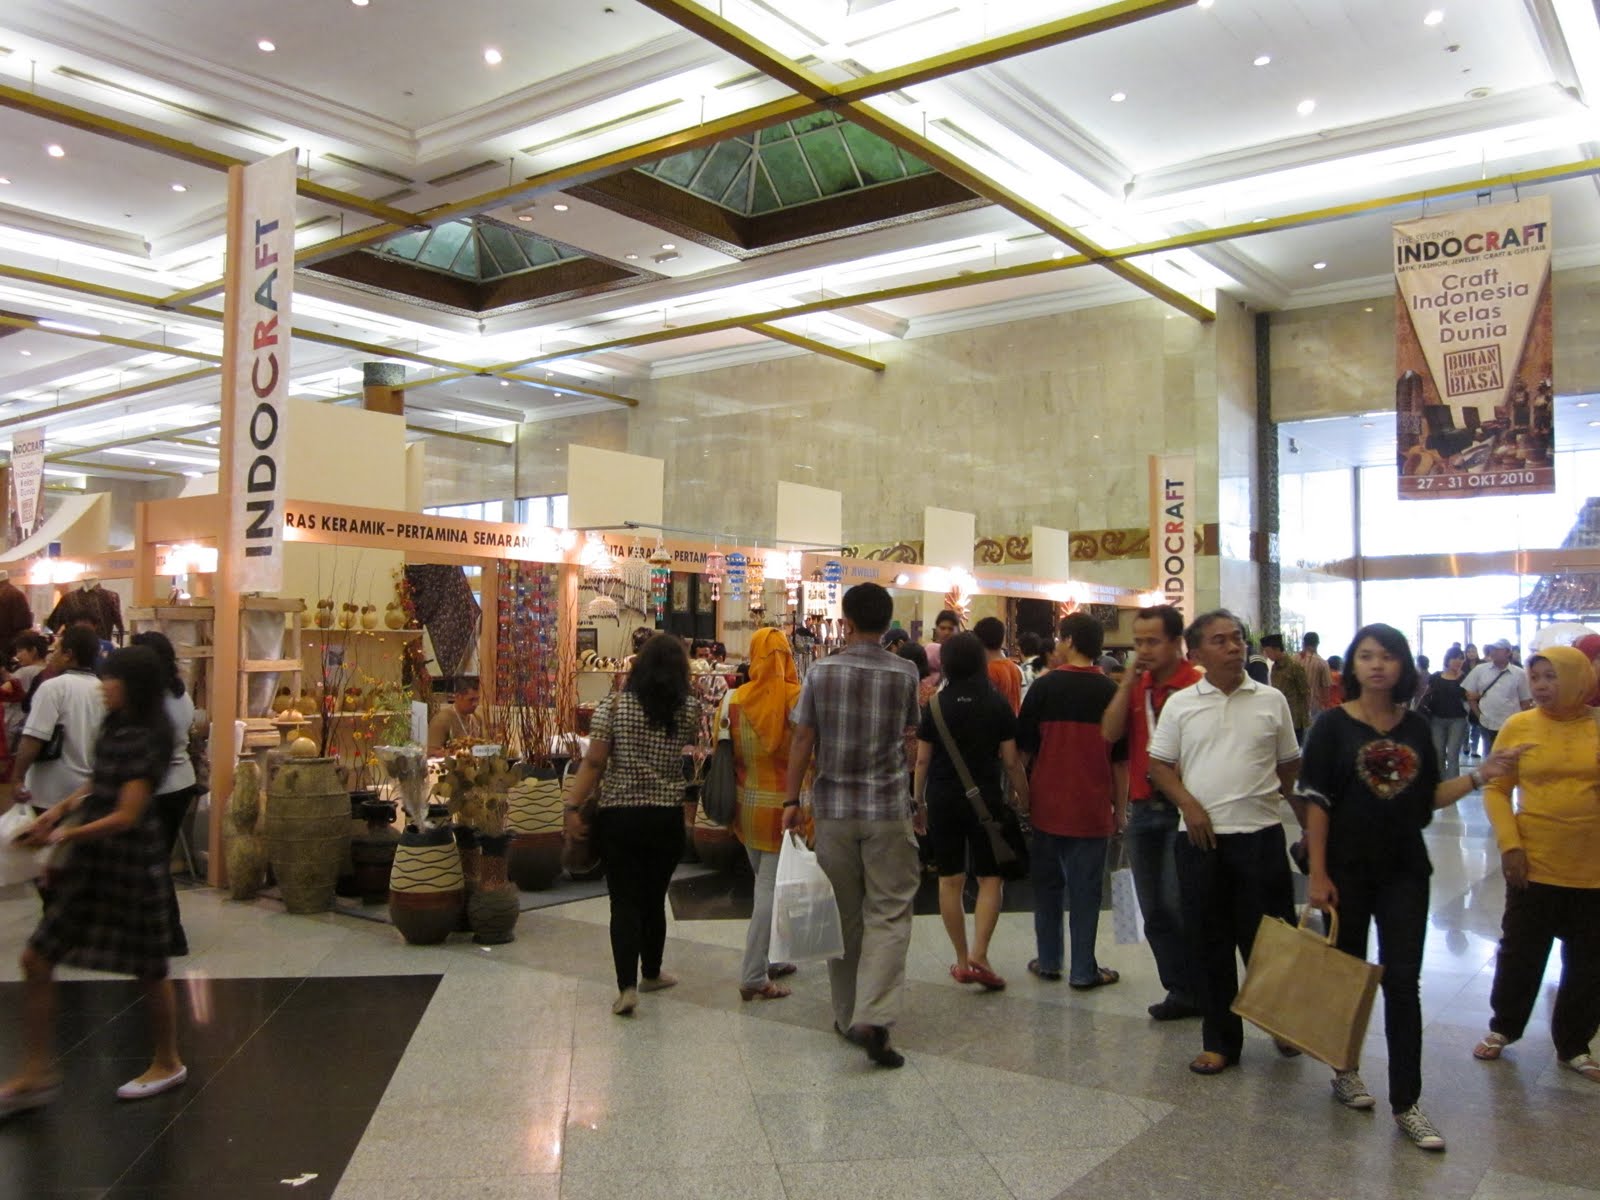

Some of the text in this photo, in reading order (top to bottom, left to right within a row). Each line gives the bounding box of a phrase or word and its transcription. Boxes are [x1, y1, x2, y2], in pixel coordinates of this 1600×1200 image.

[1397, 222, 1547, 265] INDOCRAFT
[1416, 229, 1455, 242] SEVENTH
[1441, 268, 1499, 291] Craft
[1413, 283, 1529, 310] Indonesia
[1439, 303, 1502, 326] Kelas
[1440, 322, 1508, 344] Dunia
[1448, 349, 1497, 370] BUKAN
[245, 219, 279, 557] INDOCRAFT
[1450, 370, 1499, 393] BIASA
[1416, 477, 1434, 490] 27
[1447, 475, 1463, 488] 31
[1468, 473, 1496, 487] OKT
[1500, 471, 1535, 486] 2010
[1164, 479, 1185, 612] NDOCRAFT
